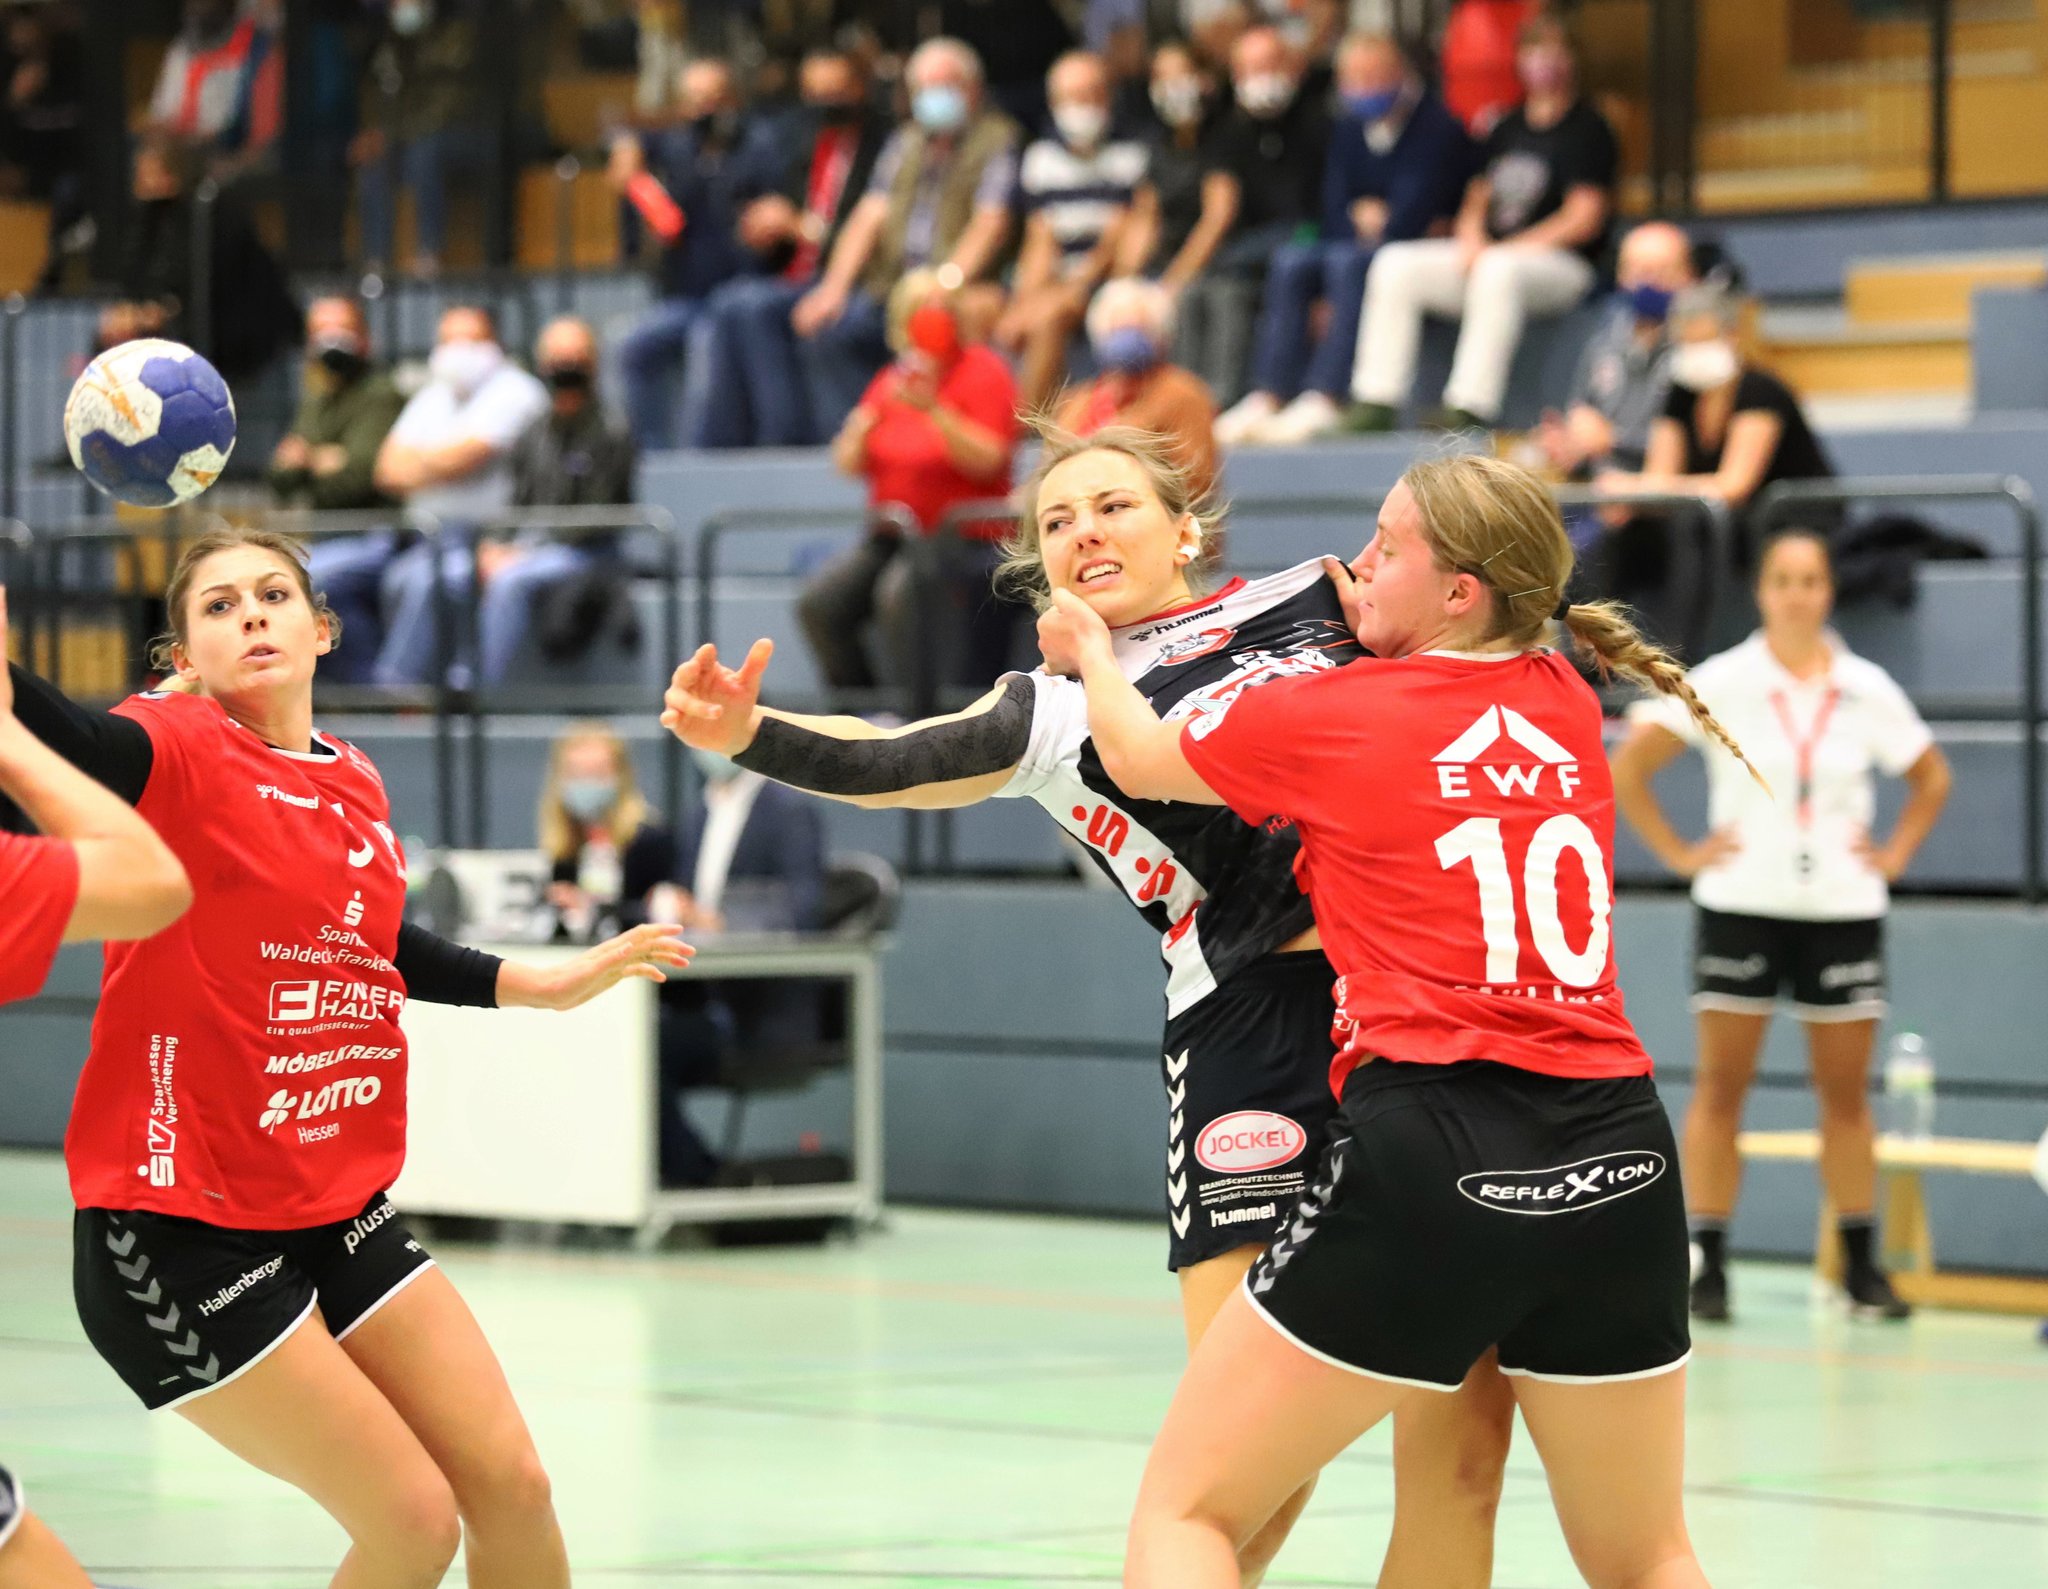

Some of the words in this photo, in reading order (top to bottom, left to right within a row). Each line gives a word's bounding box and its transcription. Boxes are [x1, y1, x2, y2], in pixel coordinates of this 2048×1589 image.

[1154, 604, 1224, 635] hummel
[273, 786, 319, 809] hummel
[1433, 814, 1611, 987] 10
[266, 1026, 285, 1036] EIN
[149, 1034, 166, 1116] Sparkassen
[160, 1036, 179, 1125] Versicherung
[296, 1076, 382, 1120] LOTTO
[297, 1122, 341, 1144] Hessen
[1210, 1130, 1291, 1155] JOCKEL
[1199, 1170, 1305, 1192] BRANDSCHUTZTECHNIK
[1210, 1202, 1277, 1228] hummel
[198, 1255, 284, 1317] Hallenberger
